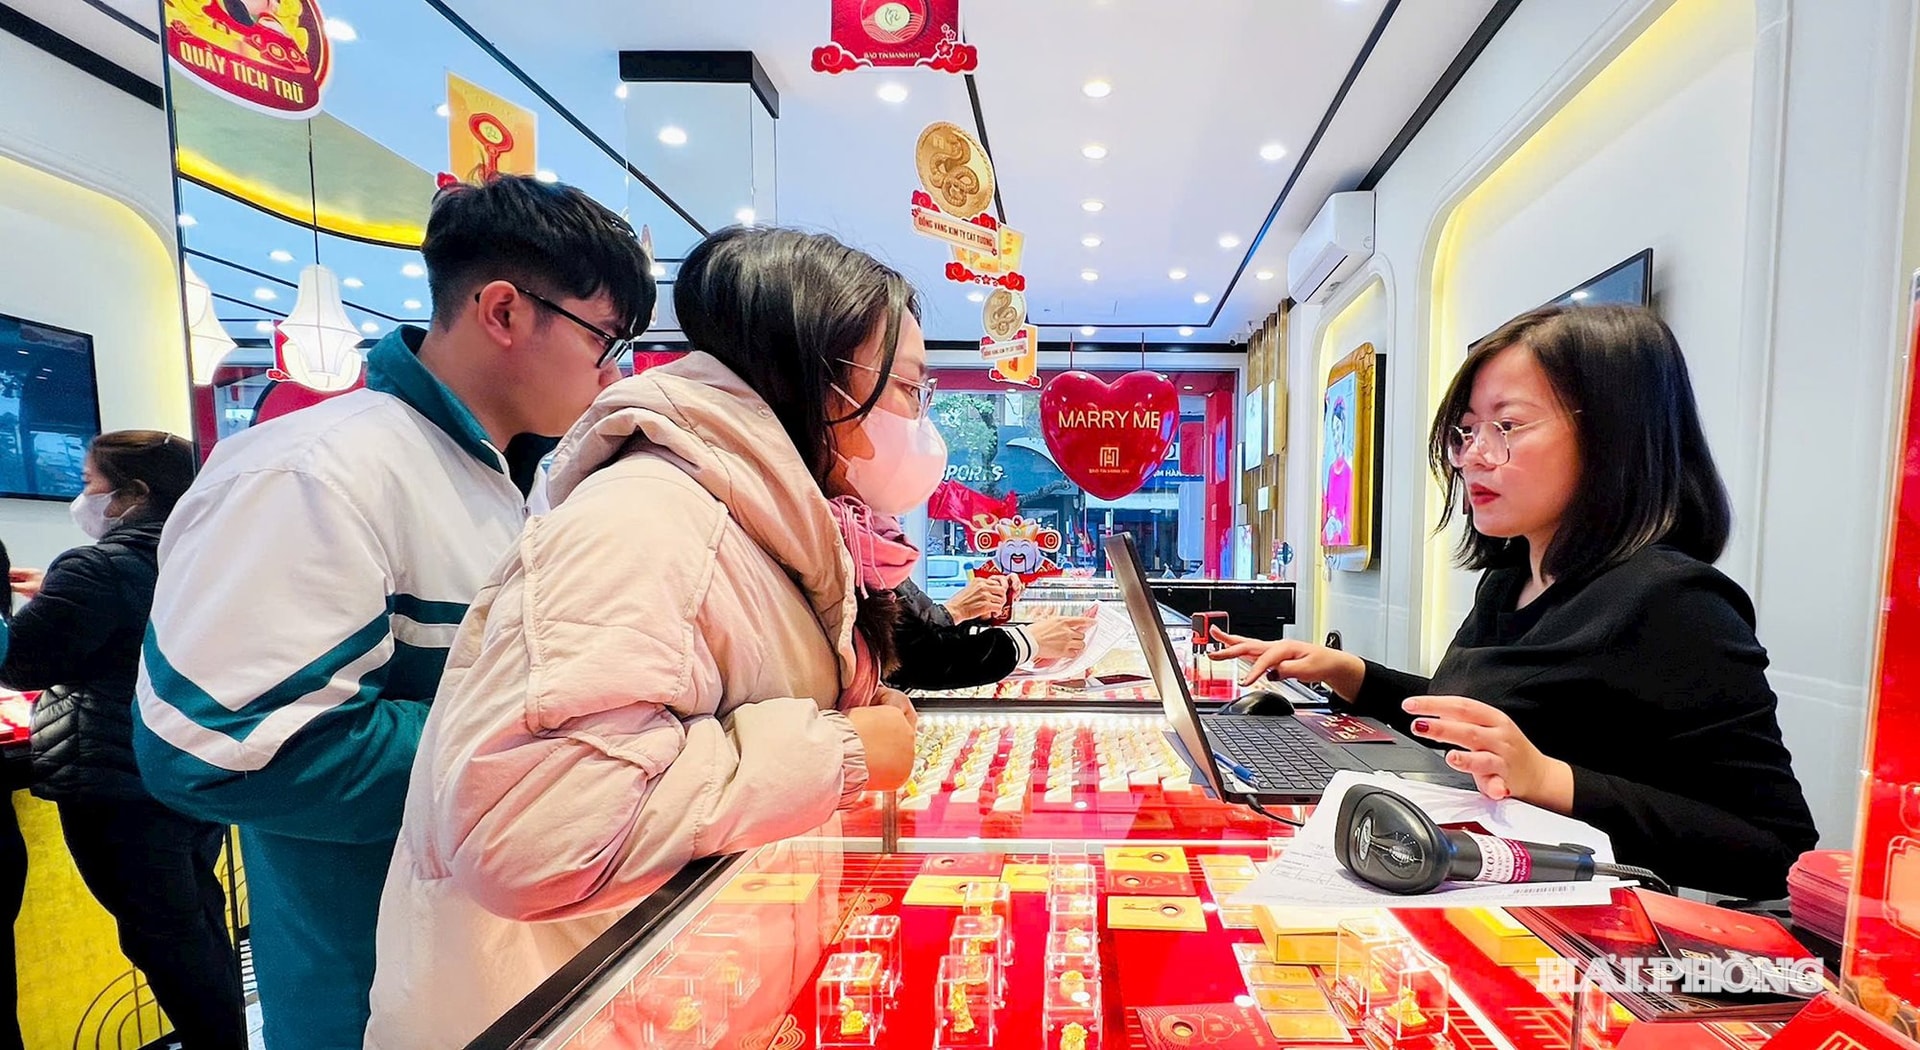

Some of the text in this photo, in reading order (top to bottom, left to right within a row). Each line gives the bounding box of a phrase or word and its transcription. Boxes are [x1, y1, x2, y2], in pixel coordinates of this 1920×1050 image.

[179, 40, 305, 104] QUẦY TÍCH TRỮ
[1058, 410, 1160, 429] MARRY ME
